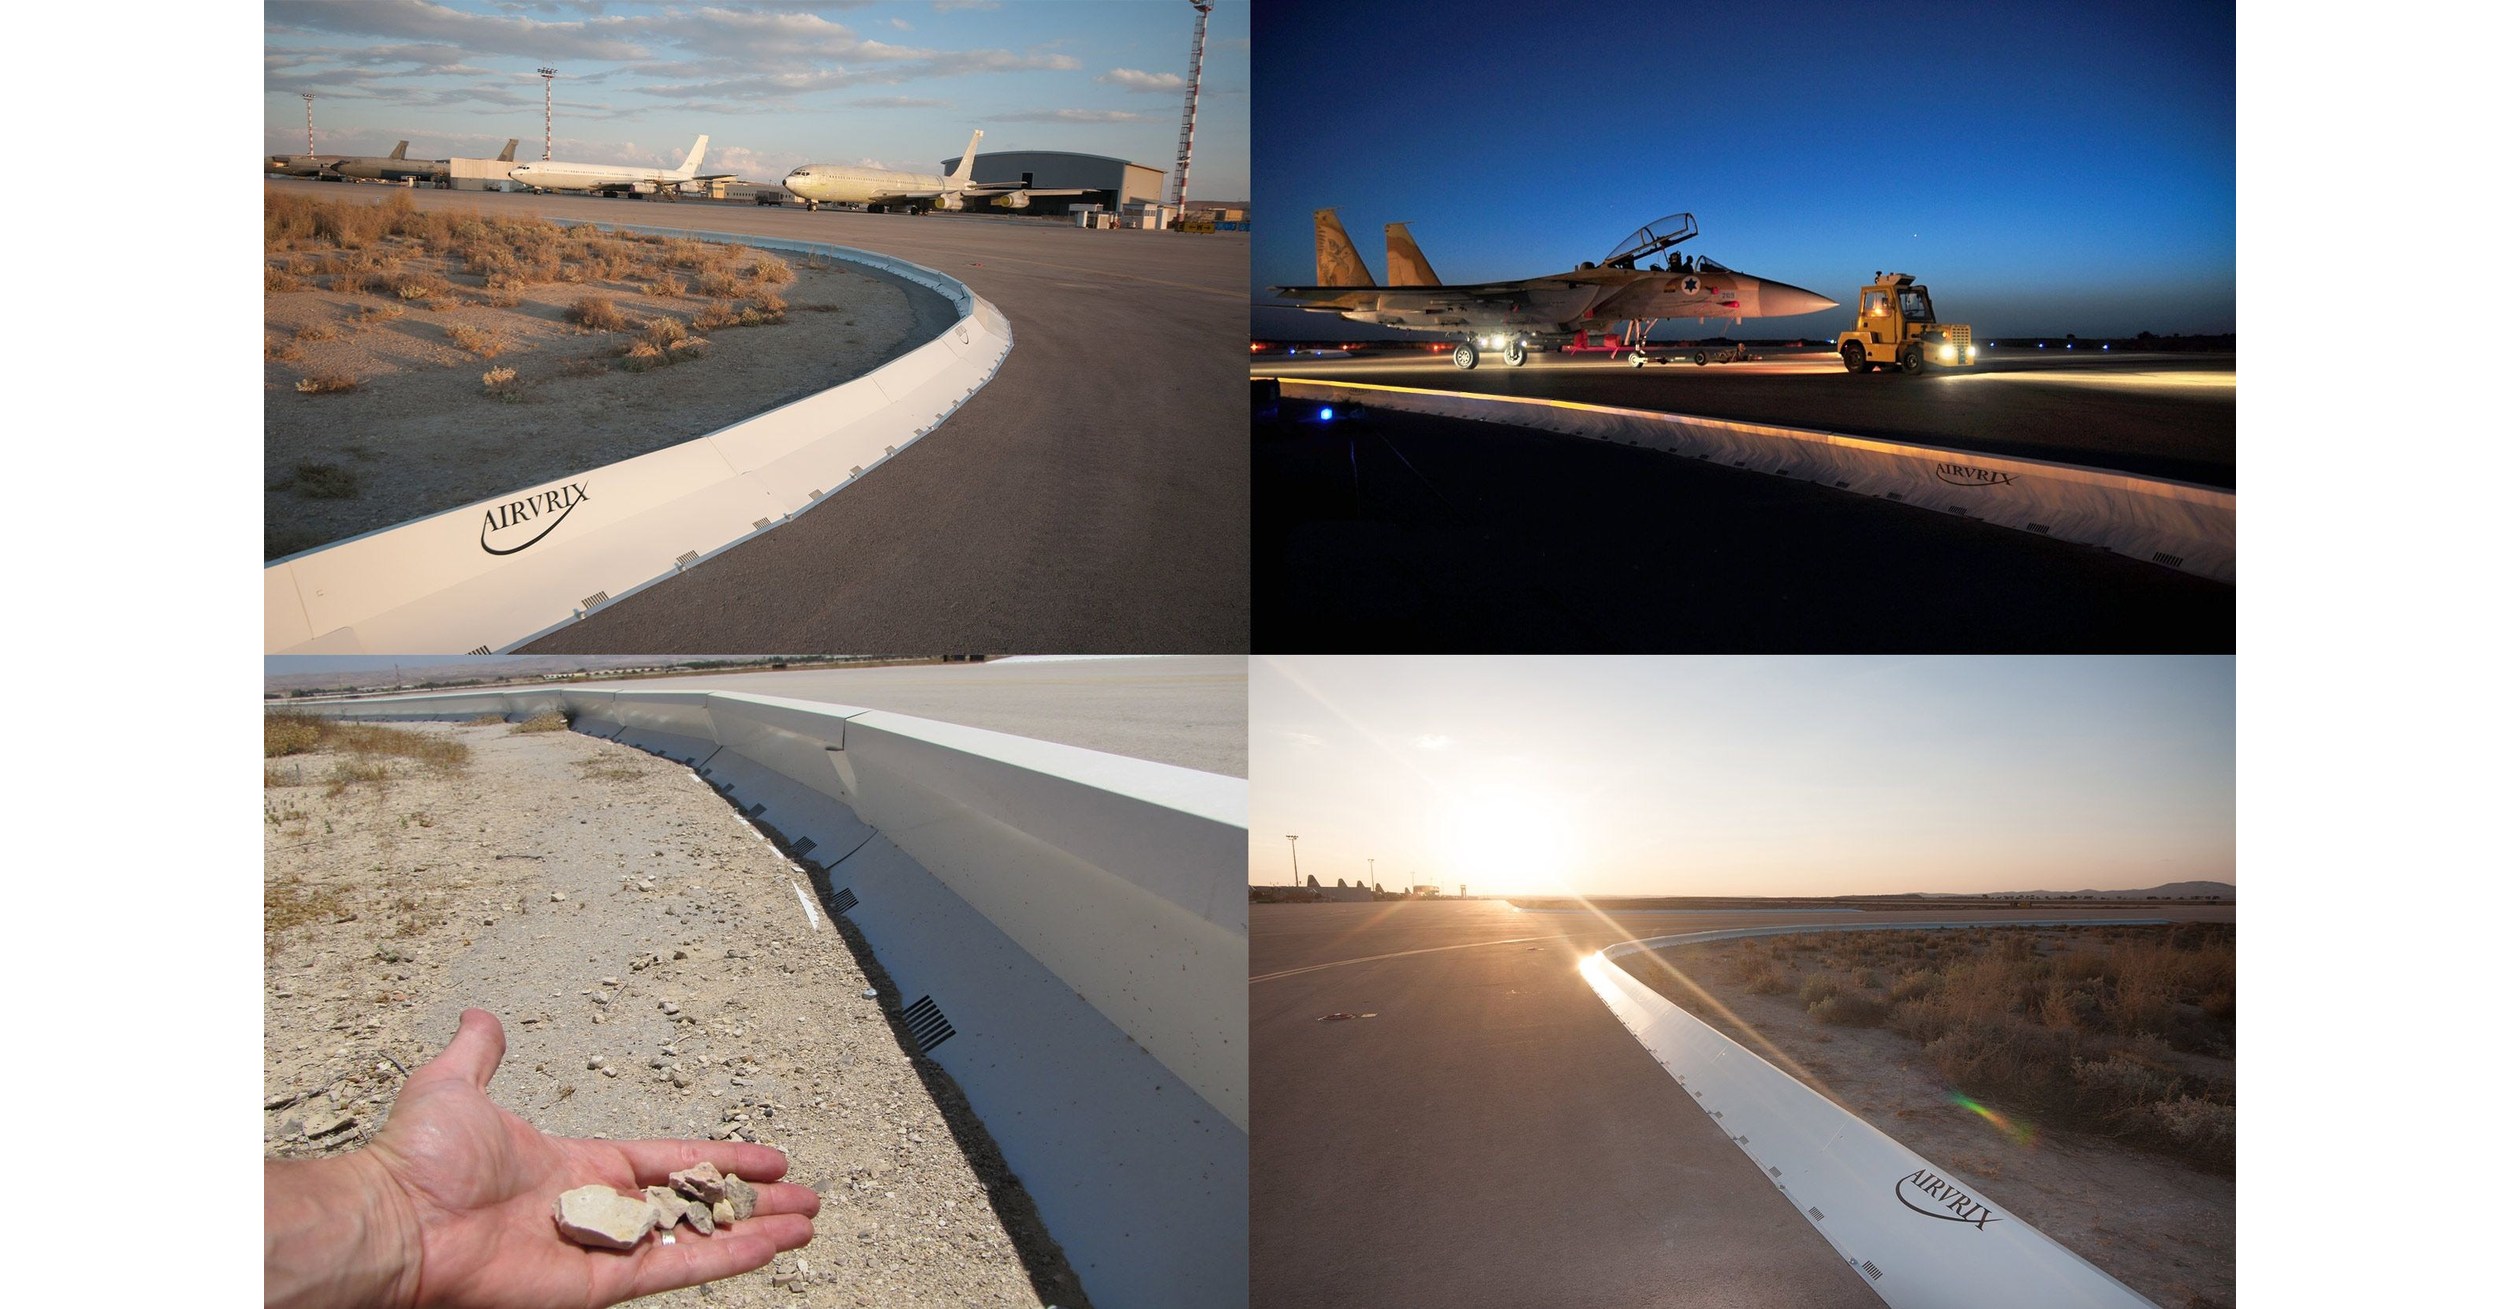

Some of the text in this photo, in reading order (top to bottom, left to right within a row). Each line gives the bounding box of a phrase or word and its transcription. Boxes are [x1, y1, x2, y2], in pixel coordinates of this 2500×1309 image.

[1937, 463, 2014, 486] AIRVRIX
[482, 480, 590, 536] AIRVRIX
[1900, 1169, 1998, 1231] AIRVRIX
